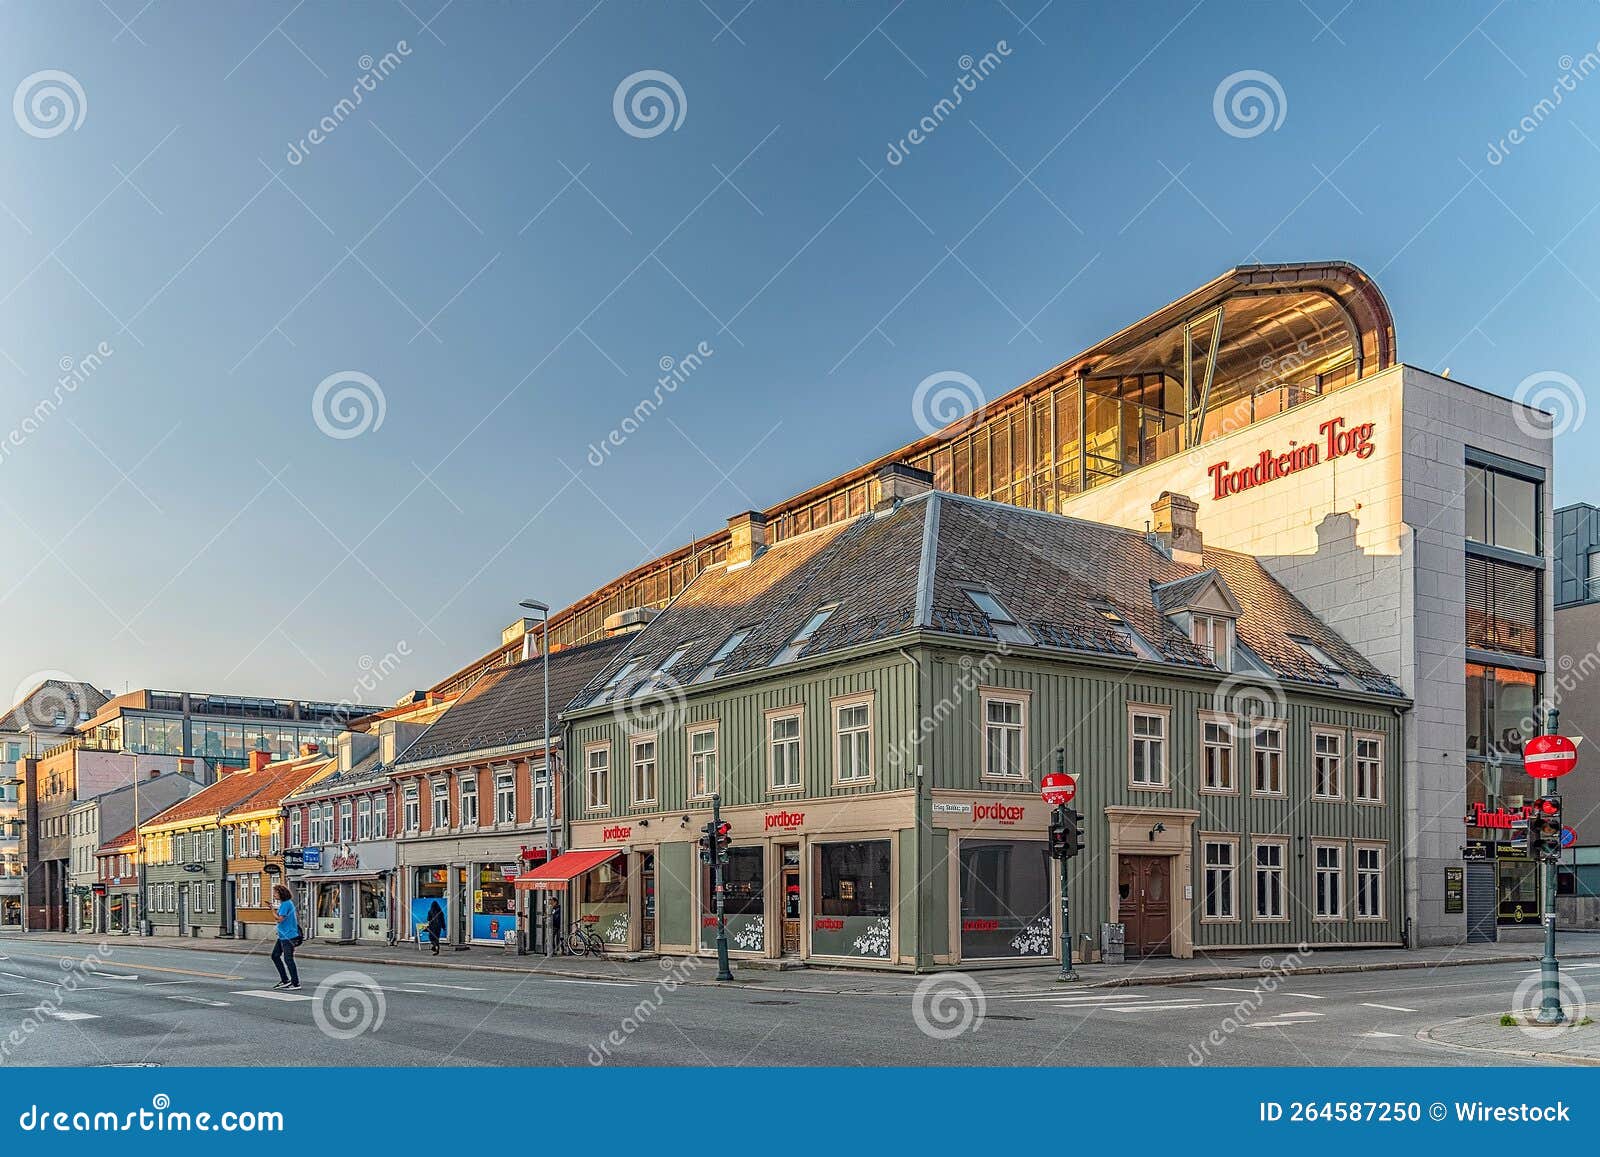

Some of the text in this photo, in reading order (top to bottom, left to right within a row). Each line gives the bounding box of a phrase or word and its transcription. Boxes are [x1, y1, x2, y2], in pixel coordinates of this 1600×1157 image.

[1208, 417, 1376, 501] Trondheim Torg
[765, 811, 805, 831] jordbær
[973, 801, 1024, 822] jordbær
